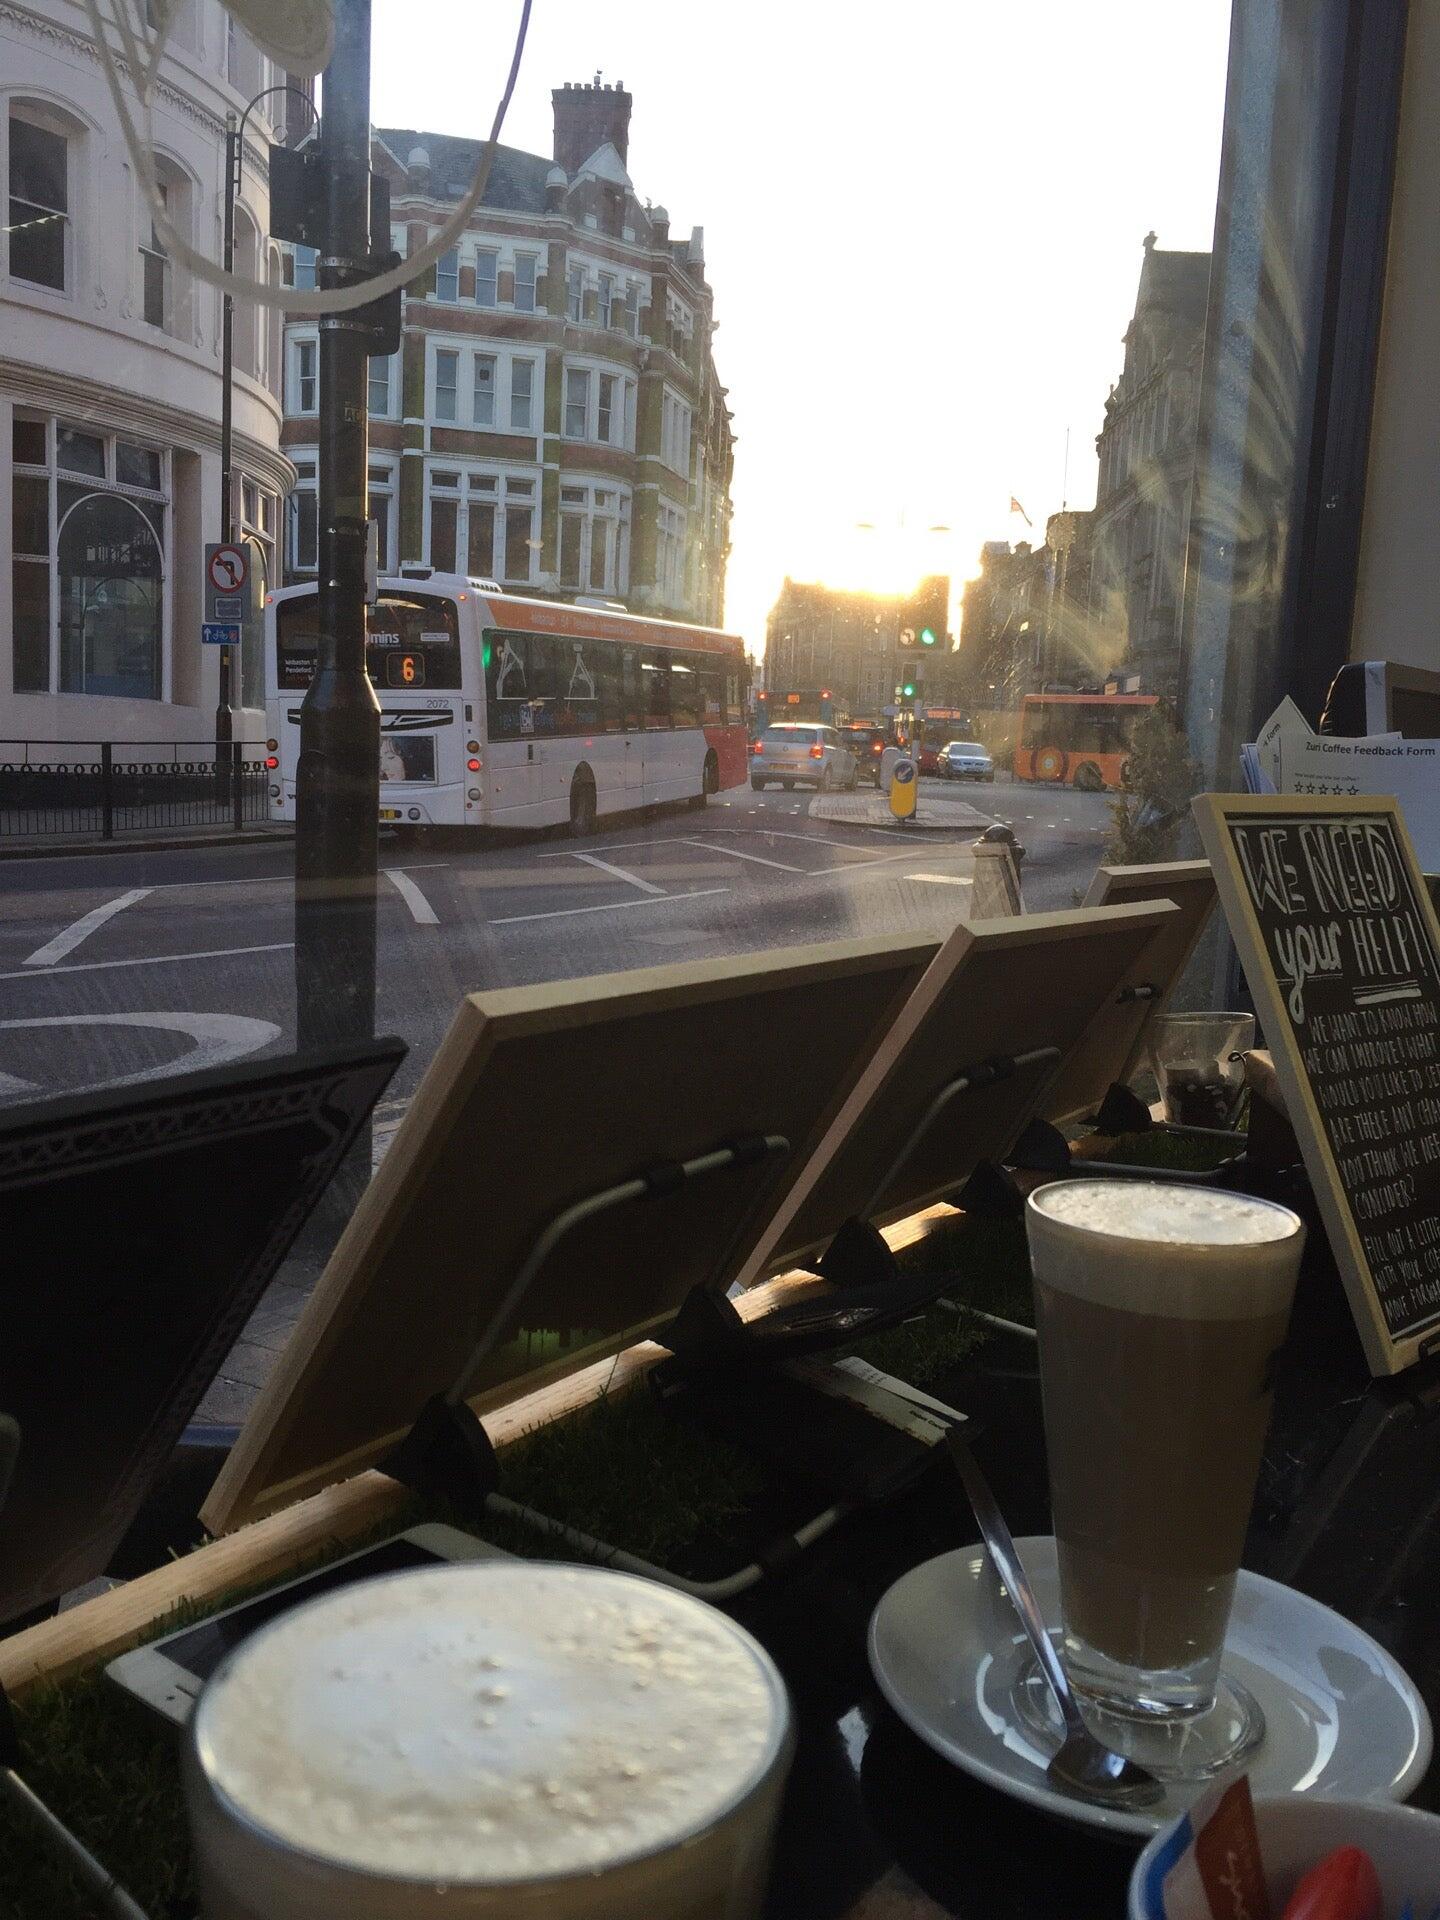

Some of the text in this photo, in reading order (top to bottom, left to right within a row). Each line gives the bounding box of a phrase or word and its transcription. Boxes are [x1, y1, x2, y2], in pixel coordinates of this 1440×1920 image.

[403, 656, 415, 681] 6
[426, 700, 449, 709] 2072
[1306, 741, 1436, 756] Zuri Coffee Feedback Form
[1235, 823, 1401, 915] WE NEED
[1274, 920, 1343, 1025] your
[1309, 1015, 1329, 1045] WE
[1360, 1009, 1379, 1035] TO
[1303, 1047, 1323, 1074] WE
[1353, 1109, 1391, 1141] THERE
